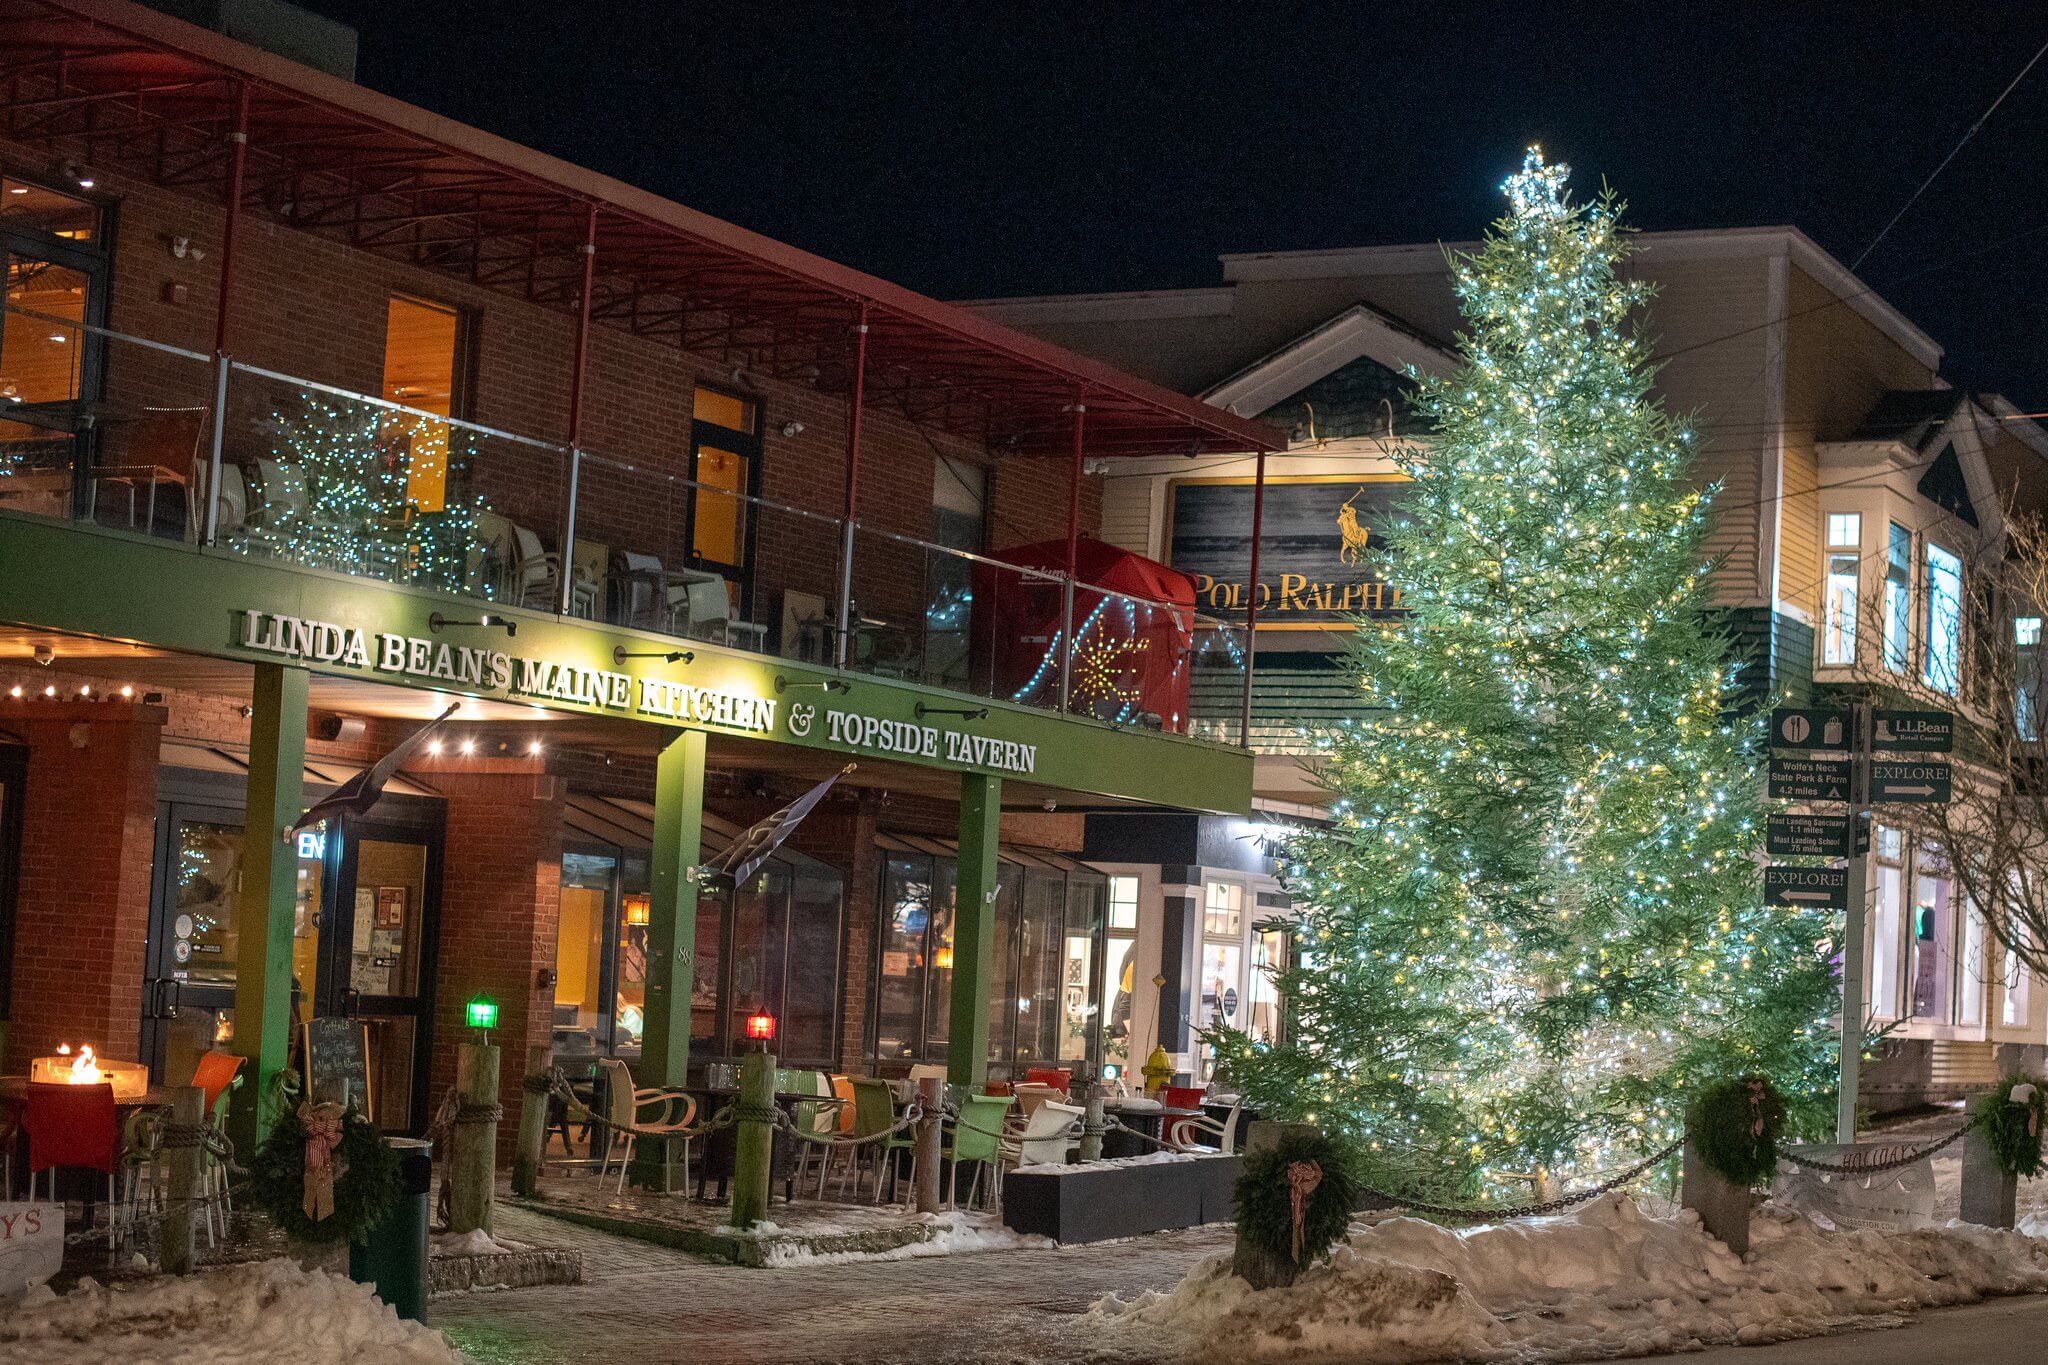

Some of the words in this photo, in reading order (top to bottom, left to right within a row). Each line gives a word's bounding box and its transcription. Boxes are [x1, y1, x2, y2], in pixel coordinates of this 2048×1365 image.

[1277, 573, 1384, 611] RALPH
[244, 608, 371, 667] LINDA
[381, 632, 512, 690] BEAN'S
[519, 656, 632, 709] MAINE
[638, 676, 777, 732] KITCHEN
[788, 702, 815, 737] &
[826, 709, 938, 758] TOPSIDE
[944, 730, 1037, 774] TAVERN
[1895, 720, 1949, 733] L.L.Bean
[1815, 763, 1837, 772] Neck
[1872, 766, 1949, 780] EXPLORE!
[1771, 772, 1794, 781] State
[1795, 773, 1815, 782] Park
[1817, 774, 1824, 783] &
[1825, 775, 1848, 784] Farm
[1779, 786, 1793, 795] 4.2
[1795, 787, 1818, 796] miles
[1786, 818, 1812, 827] Landing
[1813, 818, 1846, 829] Sanctuary
[1803, 826, 1824, 834] miles
[298, 832, 325, 859] EN
[1773, 836, 1790, 844] Mast
[1791, 836, 1817, 846] Landing
[1818, 837, 1841, 846] School
[1802, 845, 1823, 853] miles
[1767, 871, 1844, 886] EXPLORE!
[678, 945, 692, 966] 88
